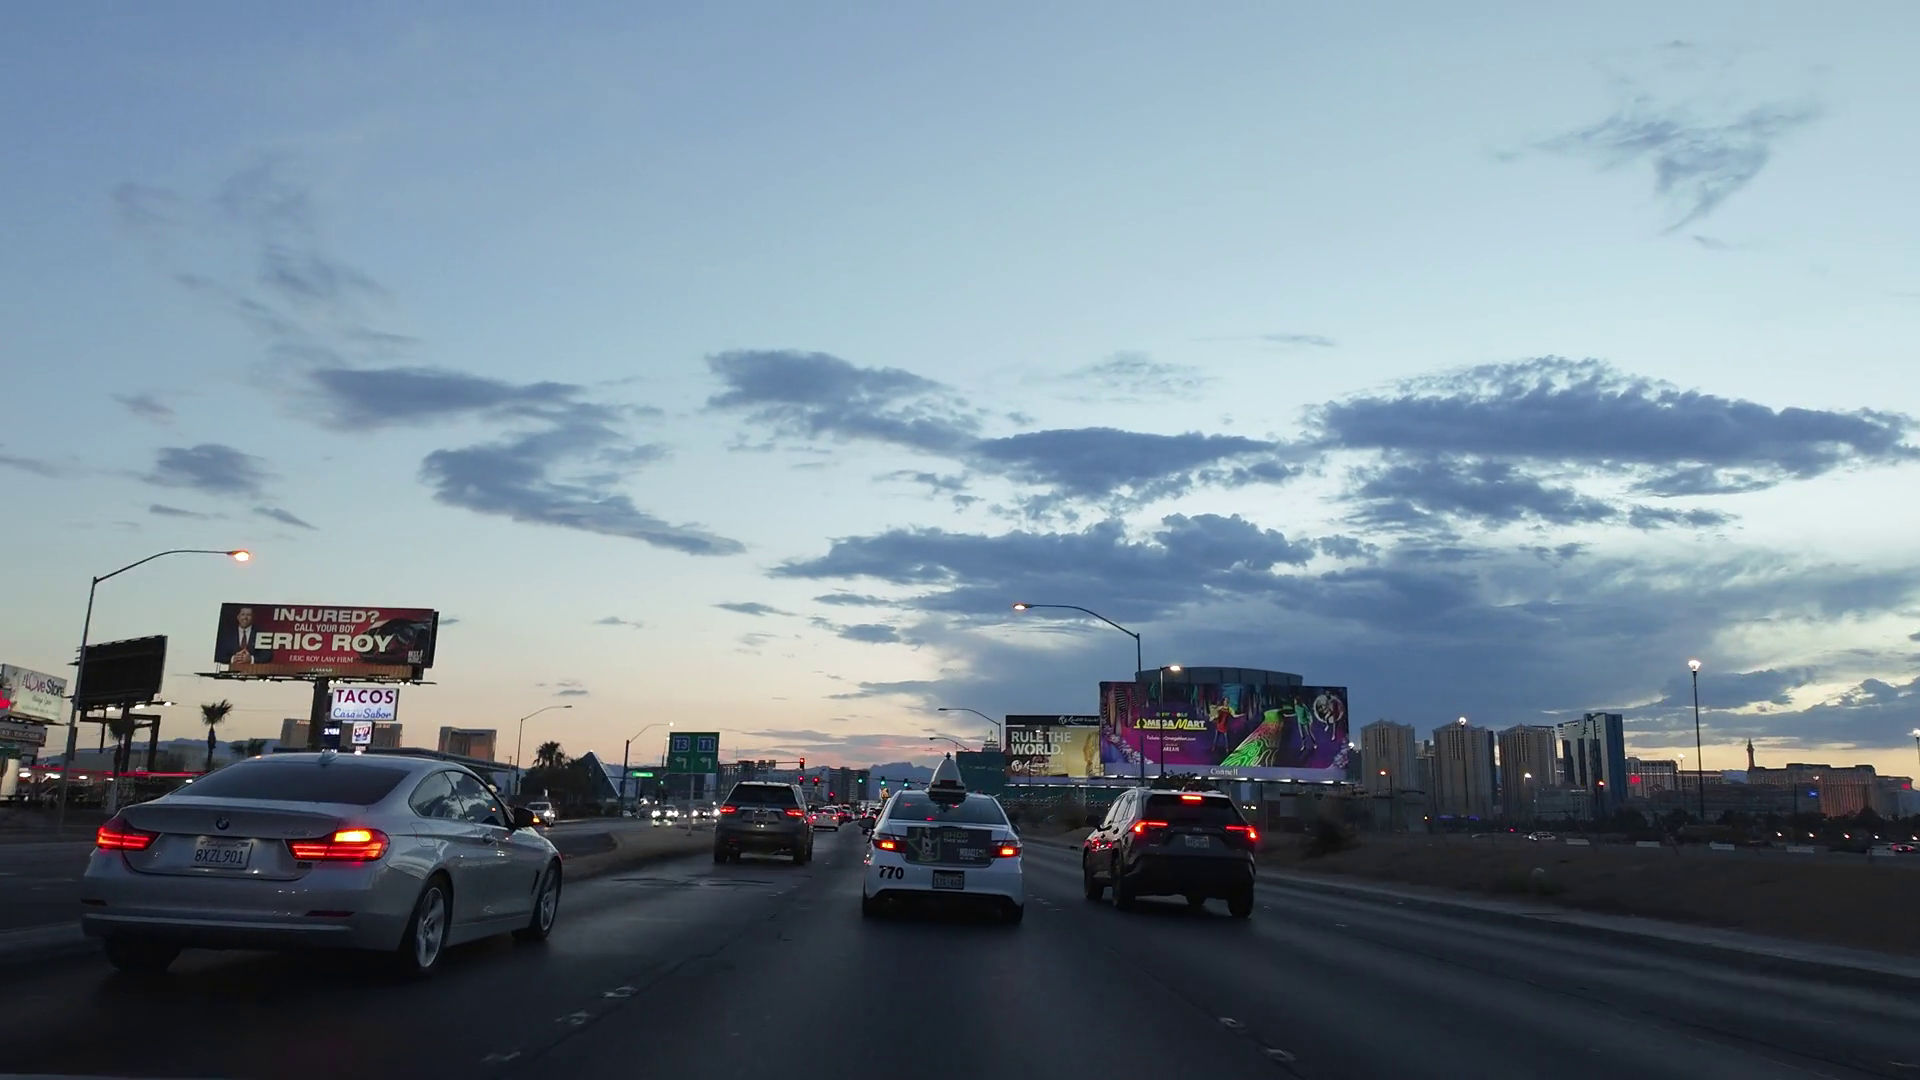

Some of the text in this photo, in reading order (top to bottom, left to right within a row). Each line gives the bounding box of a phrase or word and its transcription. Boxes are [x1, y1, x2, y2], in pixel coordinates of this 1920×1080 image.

[273, 608, 380, 623] INJURED?
[294, 624, 356, 634] CALL YOUR BOY
[254, 632, 395, 652] ERIC ROY
[336, 690, 394, 704] TACOS
[333, 708, 355, 718] Casa
[362, 708, 392, 718] Sabor
[1011, 732, 1072, 742] RULE THE
[675, 740, 688, 750] T3
[700, 740, 712, 750] T1
[1011, 744, 1064, 755] WORLD.
[1210, 768, 1238, 776] Connell
[194, 848, 244, 864] 8XZL901
[879, 865, 904, 880] 770
